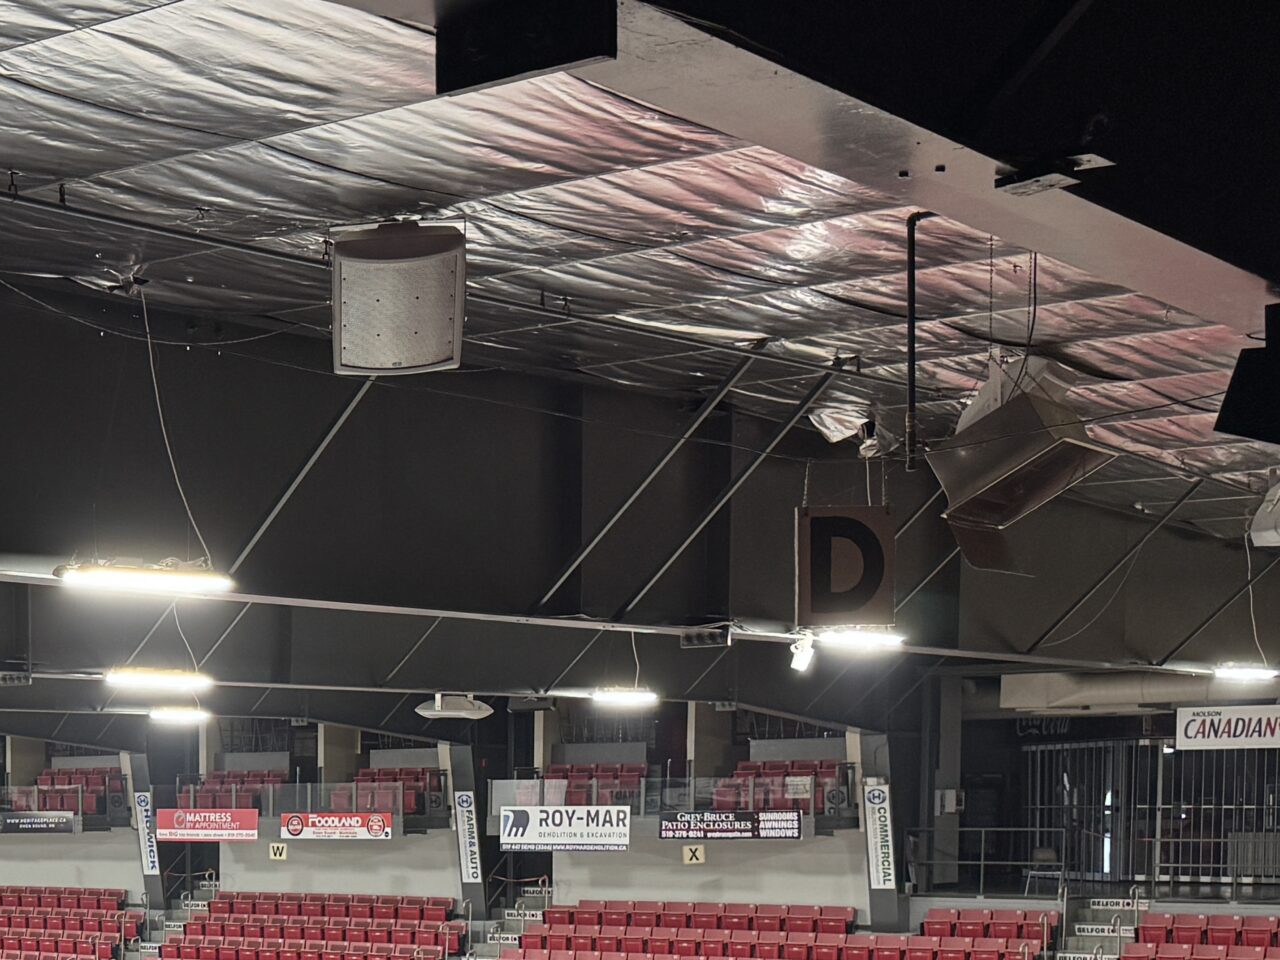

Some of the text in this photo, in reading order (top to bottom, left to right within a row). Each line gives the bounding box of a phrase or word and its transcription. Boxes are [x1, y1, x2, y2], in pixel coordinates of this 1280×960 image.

[810, 516, 885, 614] D
[1184, 717, 1276, 739] CANADIAN
[186, 812, 232, 822] MATTRESS
[308, 814, 362, 827] FOODLAND
[538, 809, 627, 828] ROY-MAR
[677, 812, 736, 822] GREY-BRUCE
[758, 812, 799, 821] SUNROOMS
[196, 822, 241, 830] APPOINTMENT
[465, 809, 476, 840] FARM
[661, 820, 752, 830] PATIO ENCLOSURES
[759, 820, 799, 829] AWNINGS
[538, 831, 577, 839] DEMOLITION
[586, 831, 627, 839] EXCAVATION
[759, 829, 799, 838] WINDOWS
[272, 845, 284, 858] W
[877, 806, 893, 886] COMMERCIAL
[688, 847, 700, 862] X
[469, 849, 479, 879] AUTO
